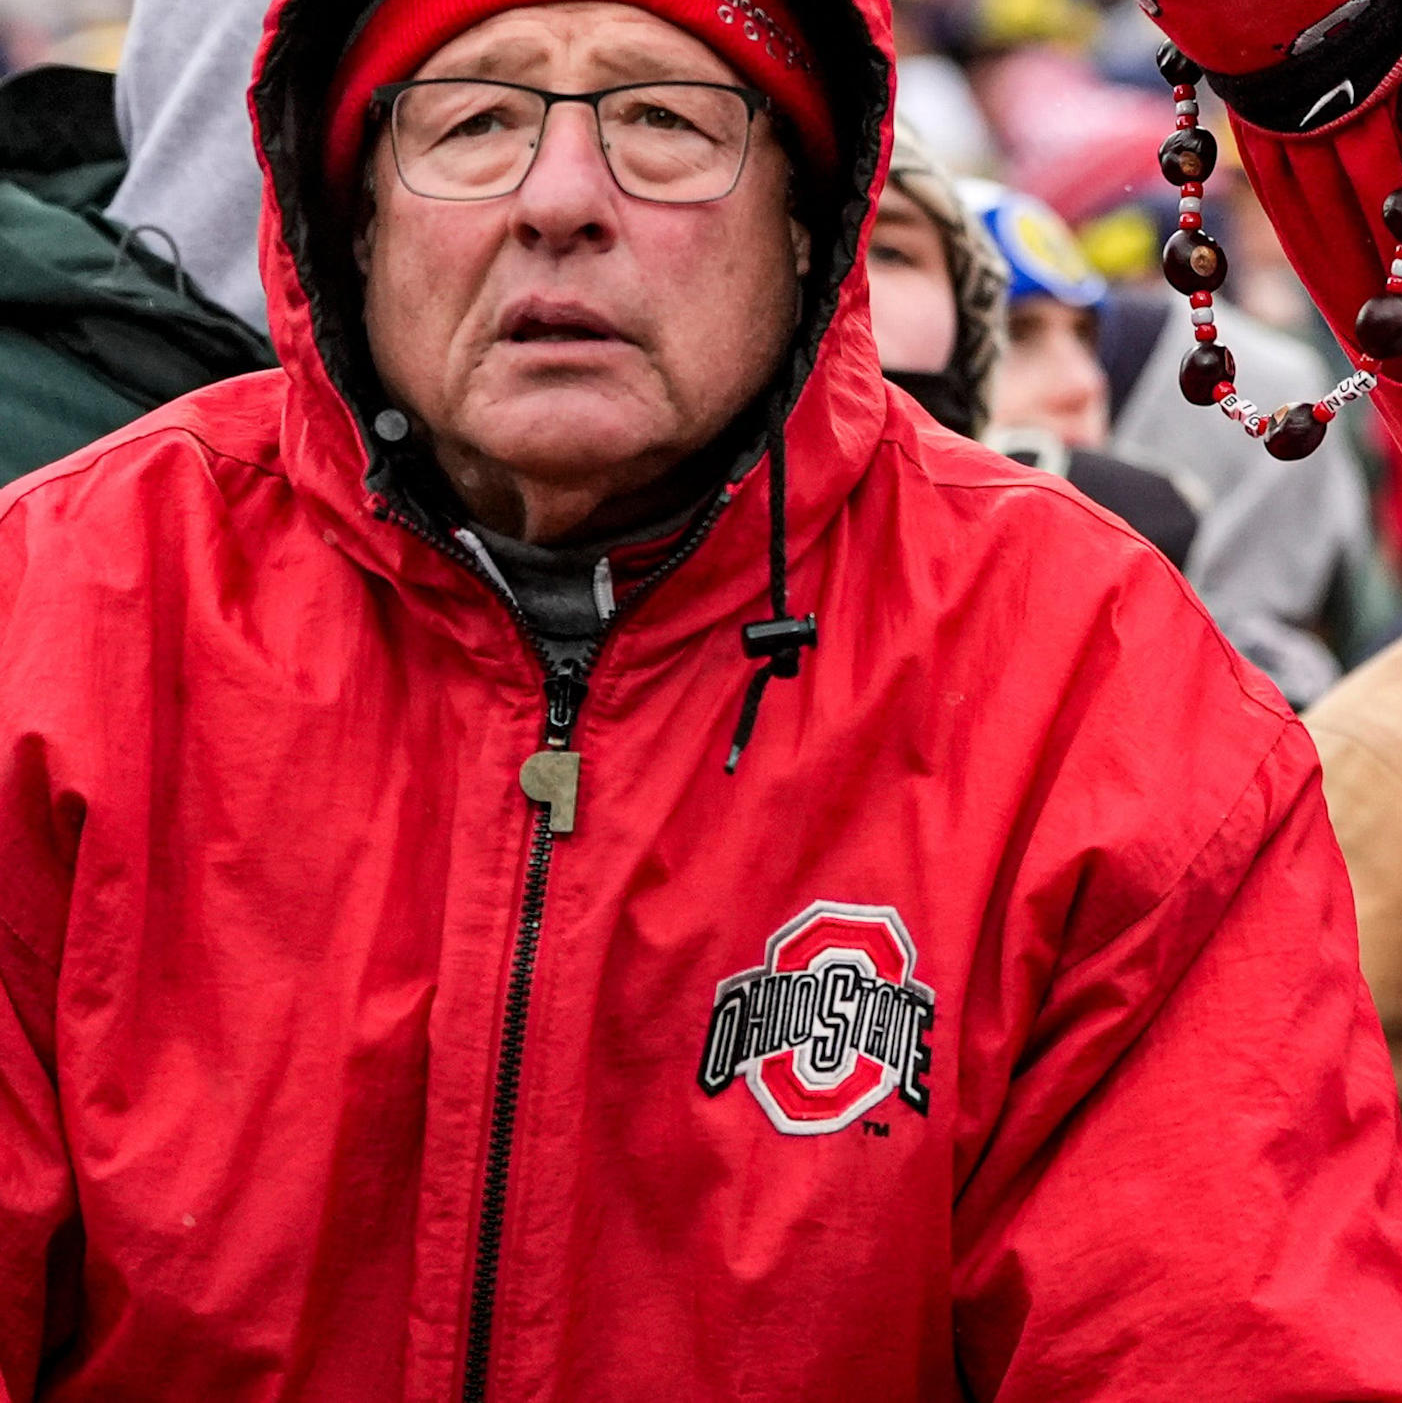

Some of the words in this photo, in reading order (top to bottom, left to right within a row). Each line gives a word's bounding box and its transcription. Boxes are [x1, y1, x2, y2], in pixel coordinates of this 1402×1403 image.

[1224, 395, 1260, 428] BIG
[1326, 377, 1372, 411] NUT
[697, 972, 818, 1098] OHIO
[811, 963, 934, 1117] STATE
